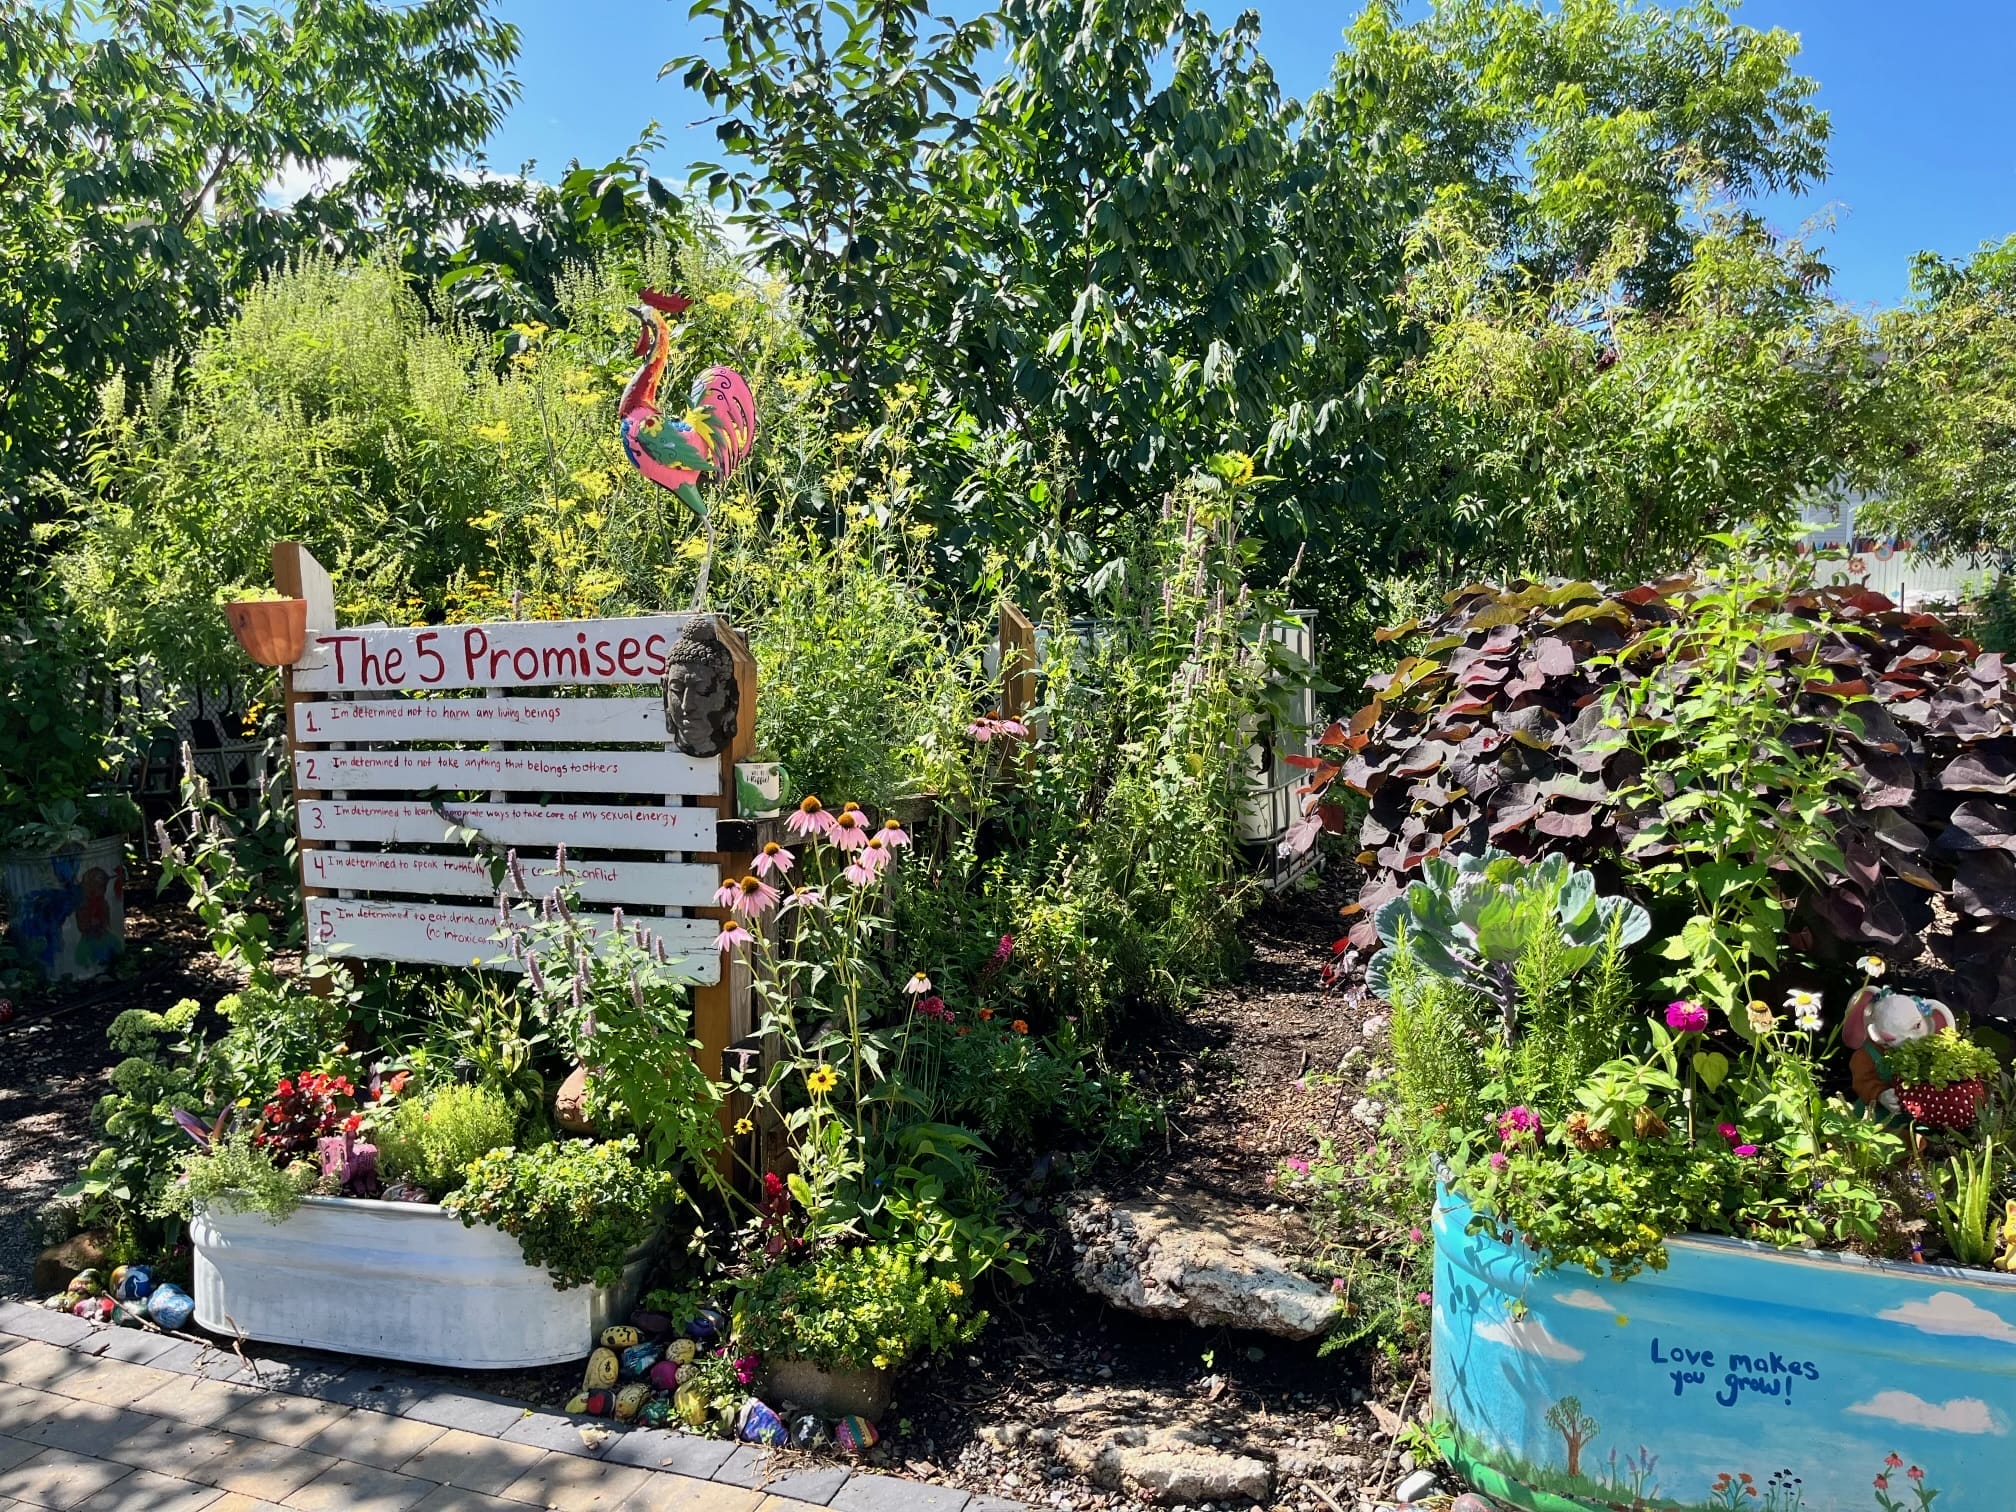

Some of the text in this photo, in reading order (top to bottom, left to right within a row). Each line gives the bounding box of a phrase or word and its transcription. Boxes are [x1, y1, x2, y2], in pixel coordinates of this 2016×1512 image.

[315, 627, 666, 686] The 5 Promises
[353, 705, 403, 718] determined
[408, 705, 422, 717] not
[426, 705, 437, 718] to
[443, 705, 470, 719] harm
[477, 708, 494, 720] any
[498, 706, 520, 722] living
[525, 706, 561, 723] beings
[351, 756, 399, 768] determined
[404, 756, 413, 768] to
[417, 757, 432, 768] not
[438, 756, 460, 769] take
[465, 757, 501, 773] anything
[505, 758, 524, 769] that
[527, 760, 568, 778] belongs
[352, 805, 400, 817] determined
[403, 806, 412, 817] to
[486, 809, 510, 821] ways
[512, 808, 521, 818] to
[523, 808, 543, 818] take
[568, 811, 578, 821] of
[582, 810, 598, 822] my
[600, 809, 633, 821] sexual
[636, 810, 678, 827] energy
[345, 855, 396, 869] determined
[400, 859, 409, 869] to
[413, 860, 438, 872] speak
[444, 859, 485, 878] truthfully
[357, 908, 409, 919] determined
[414, 912, 426, 921] to
[478, 916, 497, 926] and
[427, 923, 440, 940] (no
[1651, 1337, 1820, 1381] Love makes
[1669, 1370, 1792, 1406] you grow!
